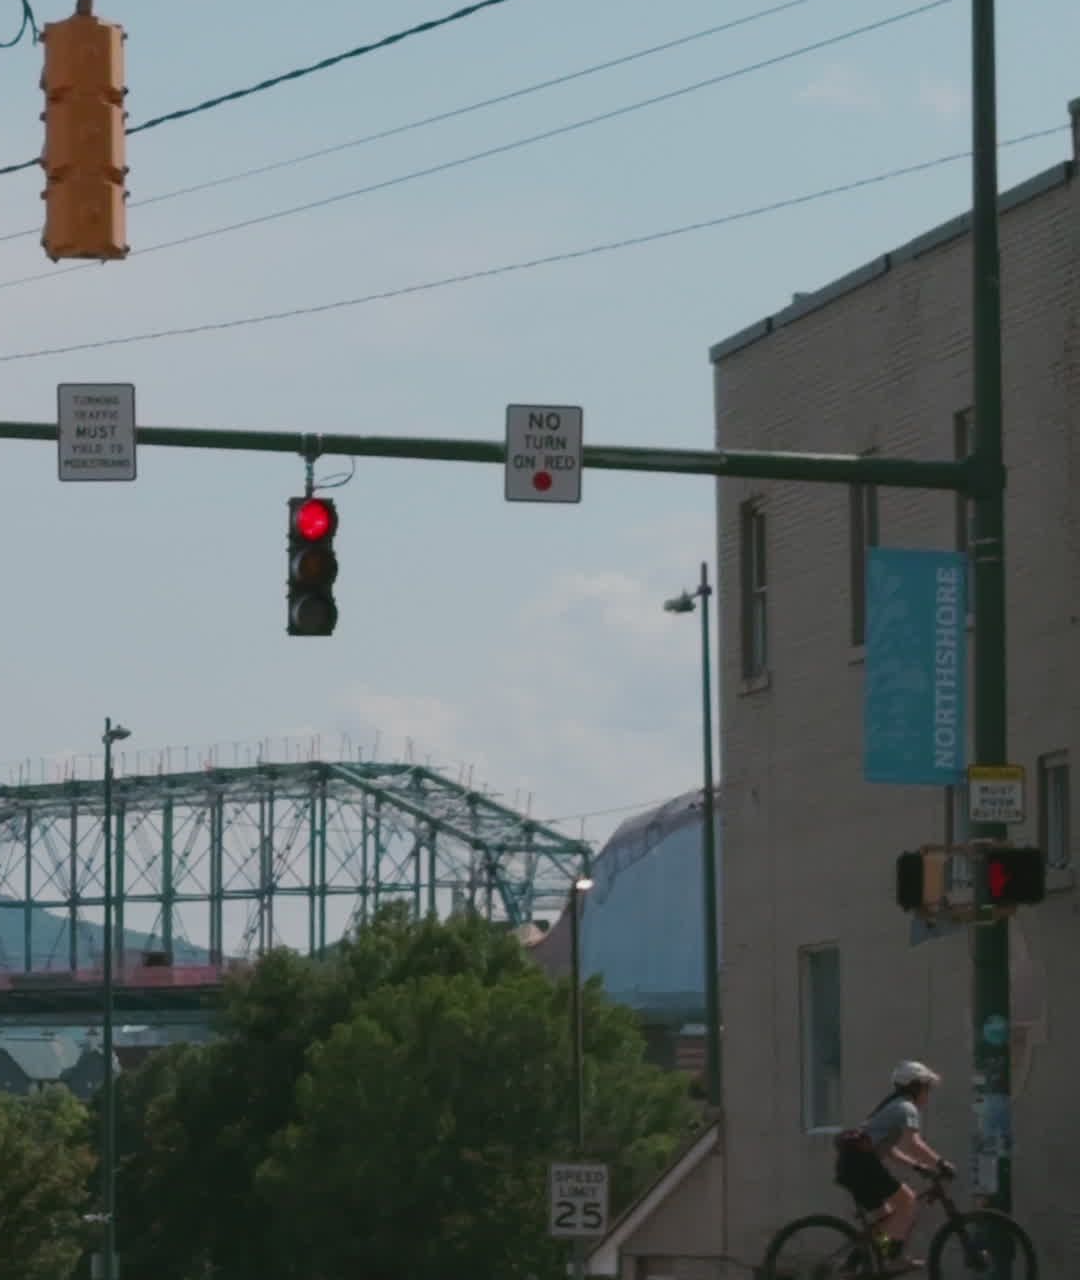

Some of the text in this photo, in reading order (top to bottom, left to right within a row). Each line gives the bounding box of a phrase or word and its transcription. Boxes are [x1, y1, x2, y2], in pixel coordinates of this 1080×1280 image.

[528, 411, 561, 431] NO
[76, 424, 116, 439] MUST
[524, 434, 568, 450] TURN
[513, 454, 576, 471] ON RED
[935, 567, 958, 769] NORTHSHORE
[555, 1169, 605, 1184] SPEED
[559, 1184, 599, 1198] LIMIT
[554, 1201, 603, 1230] 25
